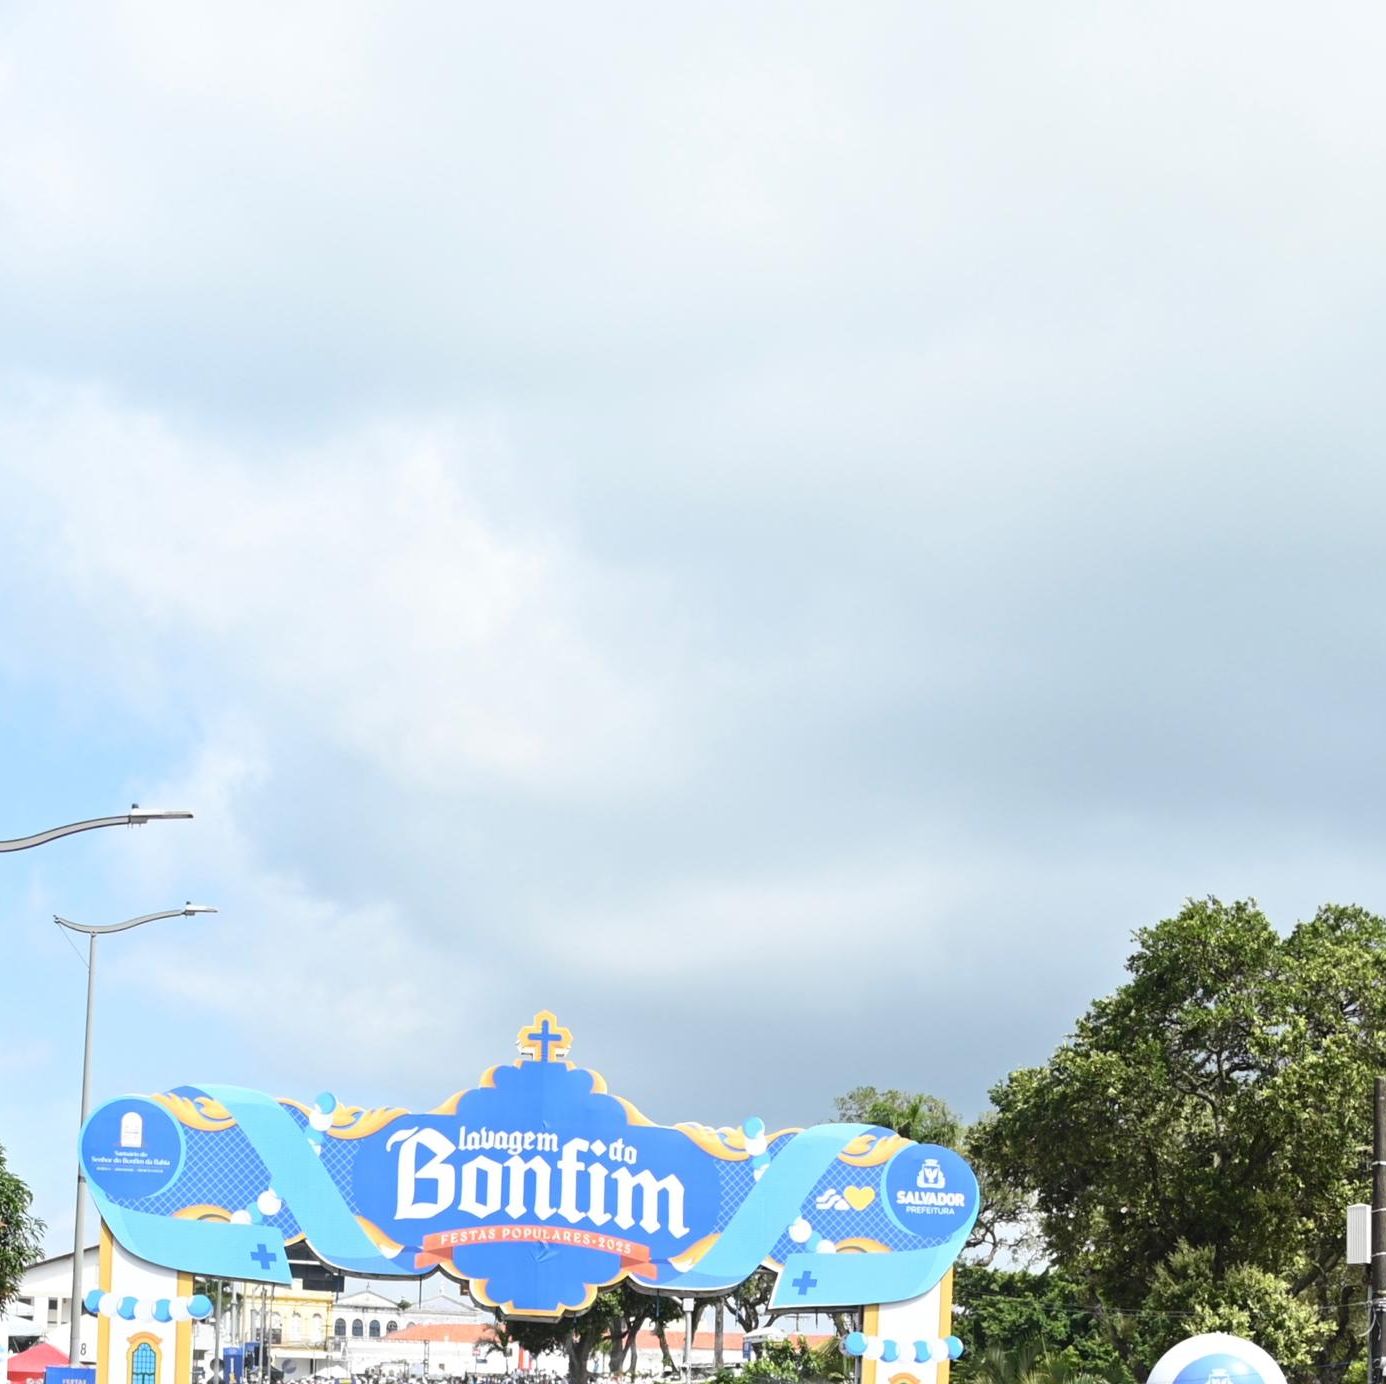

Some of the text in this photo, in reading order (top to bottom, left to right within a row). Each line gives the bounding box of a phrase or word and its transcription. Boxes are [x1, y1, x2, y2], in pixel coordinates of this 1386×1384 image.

[457, 1126, 559, 1155] lavagem
[385, 1126, 690, 1240] Bonfim
[896, 1190, 965, 1207] SALVADOR
[905, 1205, 955, 1216] PREFEITURA
[440, 1228, 496, 1246] FESTAS
[79, 1343, 87, 1356] 8
